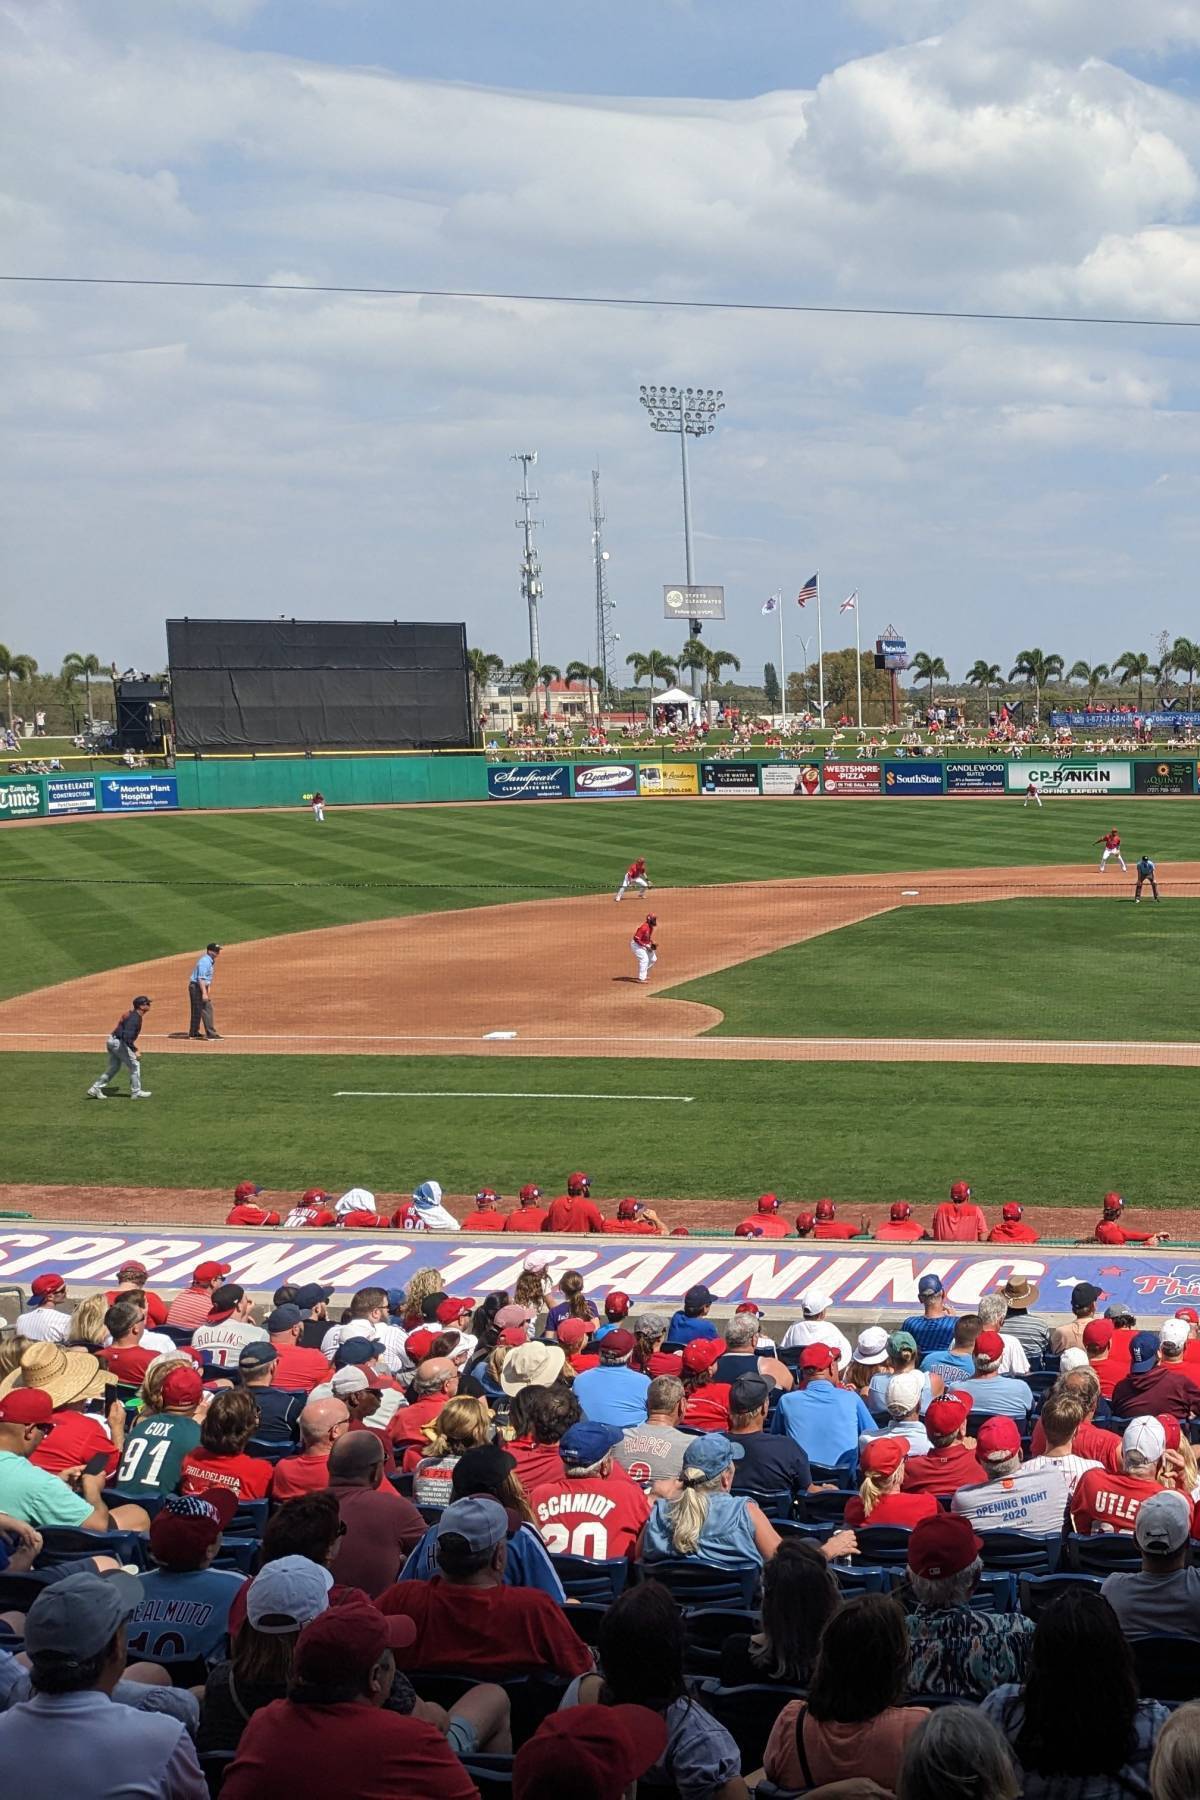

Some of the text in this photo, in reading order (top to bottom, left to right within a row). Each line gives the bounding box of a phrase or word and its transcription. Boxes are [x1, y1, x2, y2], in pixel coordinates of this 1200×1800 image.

[839, 772, 865, 780] PIZZA
[946, 764, 1004, 772] CANDLEWOOD
[1028, 770, 1110, 782] CP-RANKIN
[896, 774, 942, 784] SouthState
[1150, 776, 1184, 784] QUINTA
[121, 792, 154, 801] Hospital
[150, 784, 170, 792] Plant
[0, 788, 40, 808] Times
[440, 1246, 1047, 1306] TRAINING
[197, 1330, 243, 1347] ROLLINS
[144, 1421, 175, 1437] COX
[624, 1435, 672, 1459] HARPER
[117, 1437, 172, 1487] 91
[185, 1464, 241, 1488] PHILADELPHIA
[537, 1493, 617, 1522] SCHMIDT
[975, 1490, 1048, 1519] OPENING NIGHT
[1095, 1490, 1140, 1521] UTLE
[1002, 1507, 1028, 1522] 2020
[128, 1599, 214, 1628] EALMUTO
